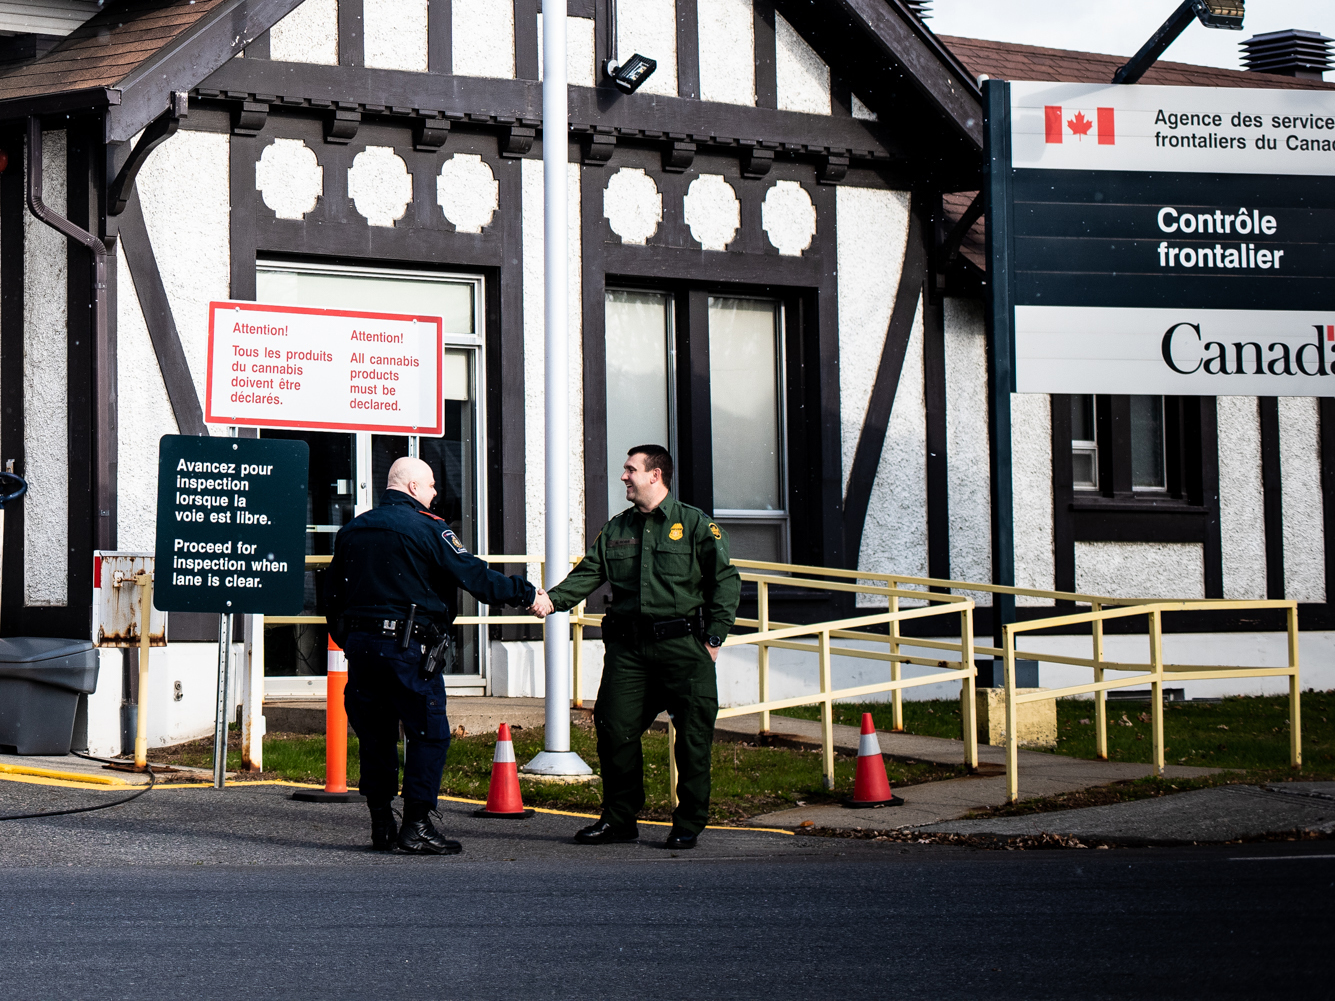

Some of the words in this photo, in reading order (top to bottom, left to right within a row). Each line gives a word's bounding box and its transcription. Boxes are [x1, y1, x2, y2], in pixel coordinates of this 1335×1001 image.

[1154, 109, 1222, 129] Agence
[1231, 112, 1263, 128] des
[1272, 114, 1335, 130] service
[1155, 132, 1246, 149] frontaliers
[1255, 134, 1277, 150] du
[1157, 207, 1277, 235] Contrôle
[1158, 242, 1284, 268] frontalier
[233, 322, 288, 336] Attention!
[350, 330, 404, 344] Attention!
[232, 345, 259, 358] Tous
[264, 347, 281, 359] les
[286, 350, 333, 363] produits
[1162, 322, 1335, 376] Canad
[350, 352, 365, 364] All
[370, 355, 420, 367] cannabis
[232, 361, 246, 372] du
[252, 363, 303, 376] cannabis
[350, 368, 400, 381] products
[231, 376, 274, 389] doivent
[279, 378, 301, 391] être
[350, 384, 377, 395] must
[382, 385, 396, 396] be
[230, 392, 283, 405] déclarés.
[349, 398, 401, 411] declared.
[177, 458, 236, 473] Avancez
[241, 464, 273, 477] pour
[176, 475, 249, 492] inspection
[176, 492, 229, 509] lorsque
[234, 494, 246, 507] la
[175, 509, 204, 522] voie
[210, 511, 231, 523] est
[236, 511, 271, 525] libre.
[174, 539, 232, 553] Proceed
[237, 541, 257, 554] for
[173, 556, 245, 572] inspection
[251, 559, 288, 572] when
[173, 572, 202, 586] lane
[208, 574, 220, 586] is
[225, 574, 262, 588] clear.
